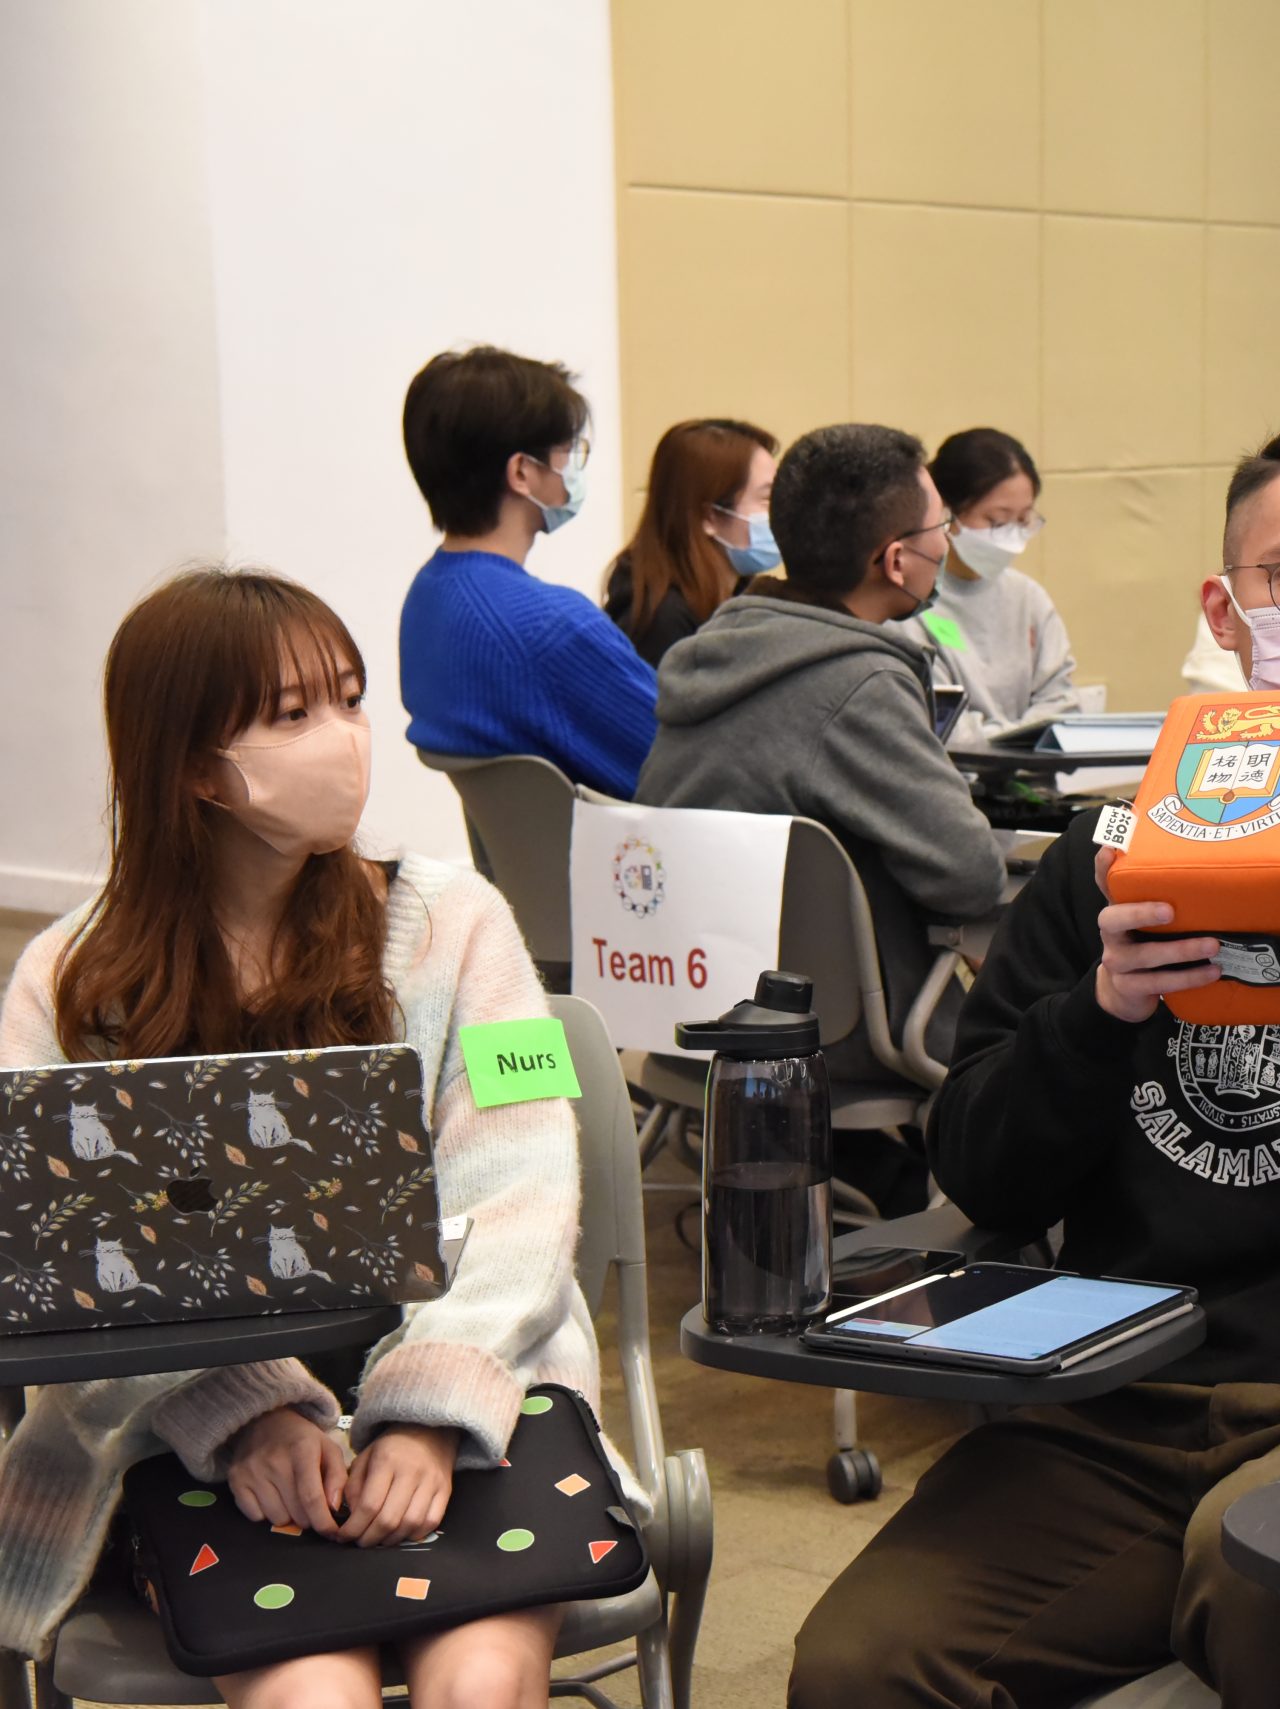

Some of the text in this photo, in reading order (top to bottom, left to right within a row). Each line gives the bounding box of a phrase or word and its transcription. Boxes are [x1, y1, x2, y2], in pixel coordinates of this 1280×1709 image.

[1103, 811, 1120, 841] CATCH
[1112, 813, 1132, 844] BOX
[1151, 807, 1206, 838] SAPIENTIA
[1214, 826, 1235, 839] ET
[591, 937, 708, 989] Team 6
[496, 1051, 556, 1075] Nurs
